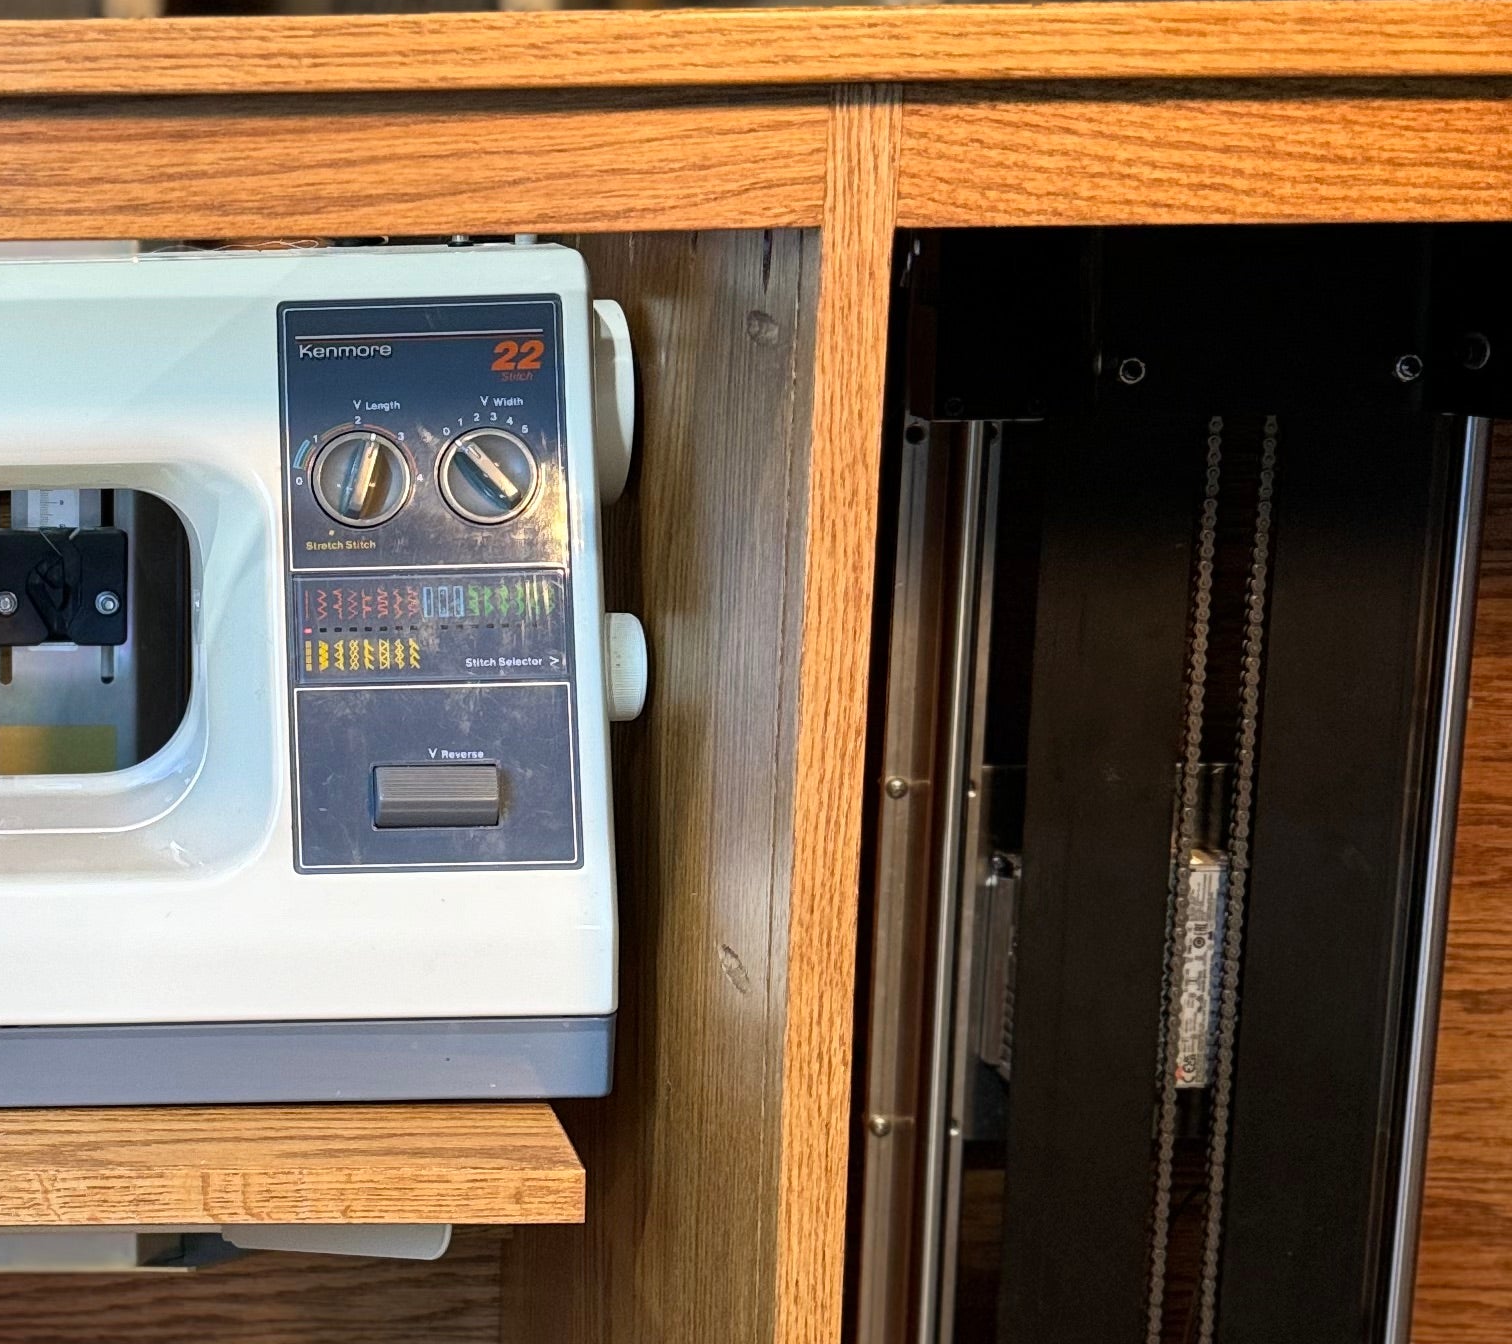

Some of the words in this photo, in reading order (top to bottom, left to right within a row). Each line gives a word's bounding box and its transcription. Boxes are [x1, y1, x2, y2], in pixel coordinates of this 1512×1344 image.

[298, 344, 392, 359] Kenmore
[490, 339, 545, 371] 22
[500, 371, 534, 382] Stitch
[365, 400, 401, 412] Length
[493, 396, 524, 407] Width
[473, 412, 480, 422] 2
[490, 412, 498, 421] 3
[506, 416, 513, 426] 4
[354, 415, 362, 425] 2
[397, 431, 405, 441] 3
[305, 540, 344, 551] Stretch
[345, 540, 377, 550] Stitch
[465, 657, 497, 668] Stitch
[498, 656, 543, 667] Selector
[441, 749, 484, 759] Reverse
